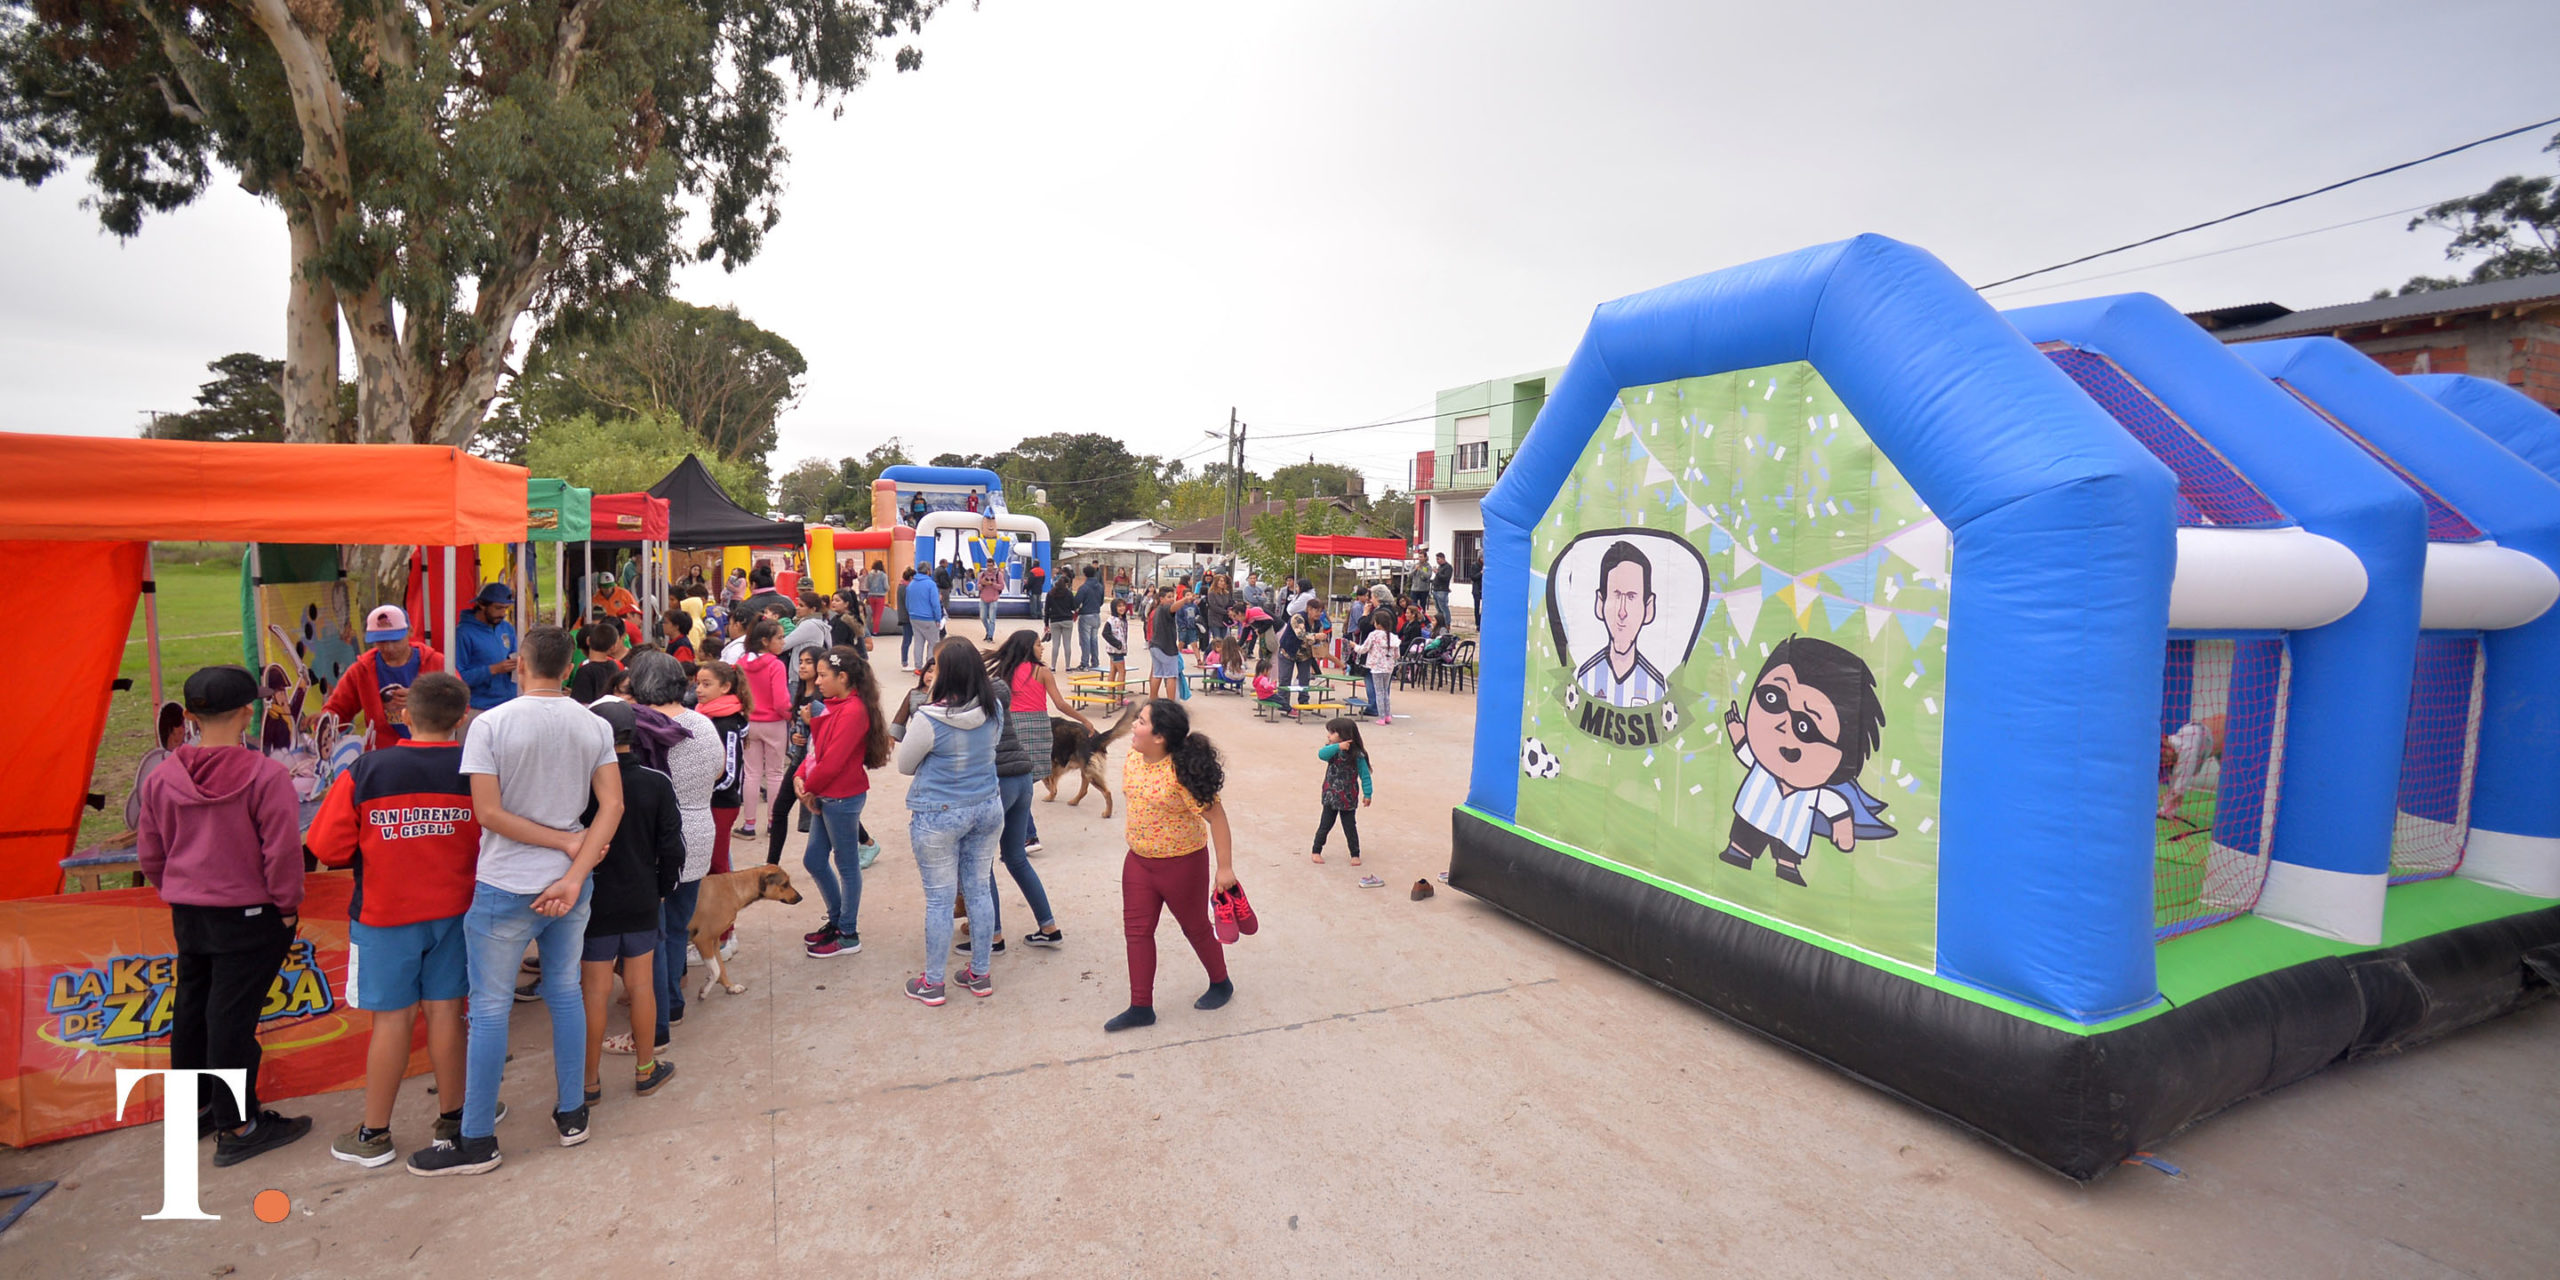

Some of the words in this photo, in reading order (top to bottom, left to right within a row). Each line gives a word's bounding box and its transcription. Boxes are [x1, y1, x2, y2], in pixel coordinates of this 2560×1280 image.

[1579, 701, 1658, 746] MESSI
[370, 809, 400, 825] SAN
[401, 807, 471, 824] LORENZO
[382, 826, 398, 840] V.
[400, 823, 455, 838] GESELL
[52, 972, 104, 1008] LA
[64, 1010, 104, 1036] DE
